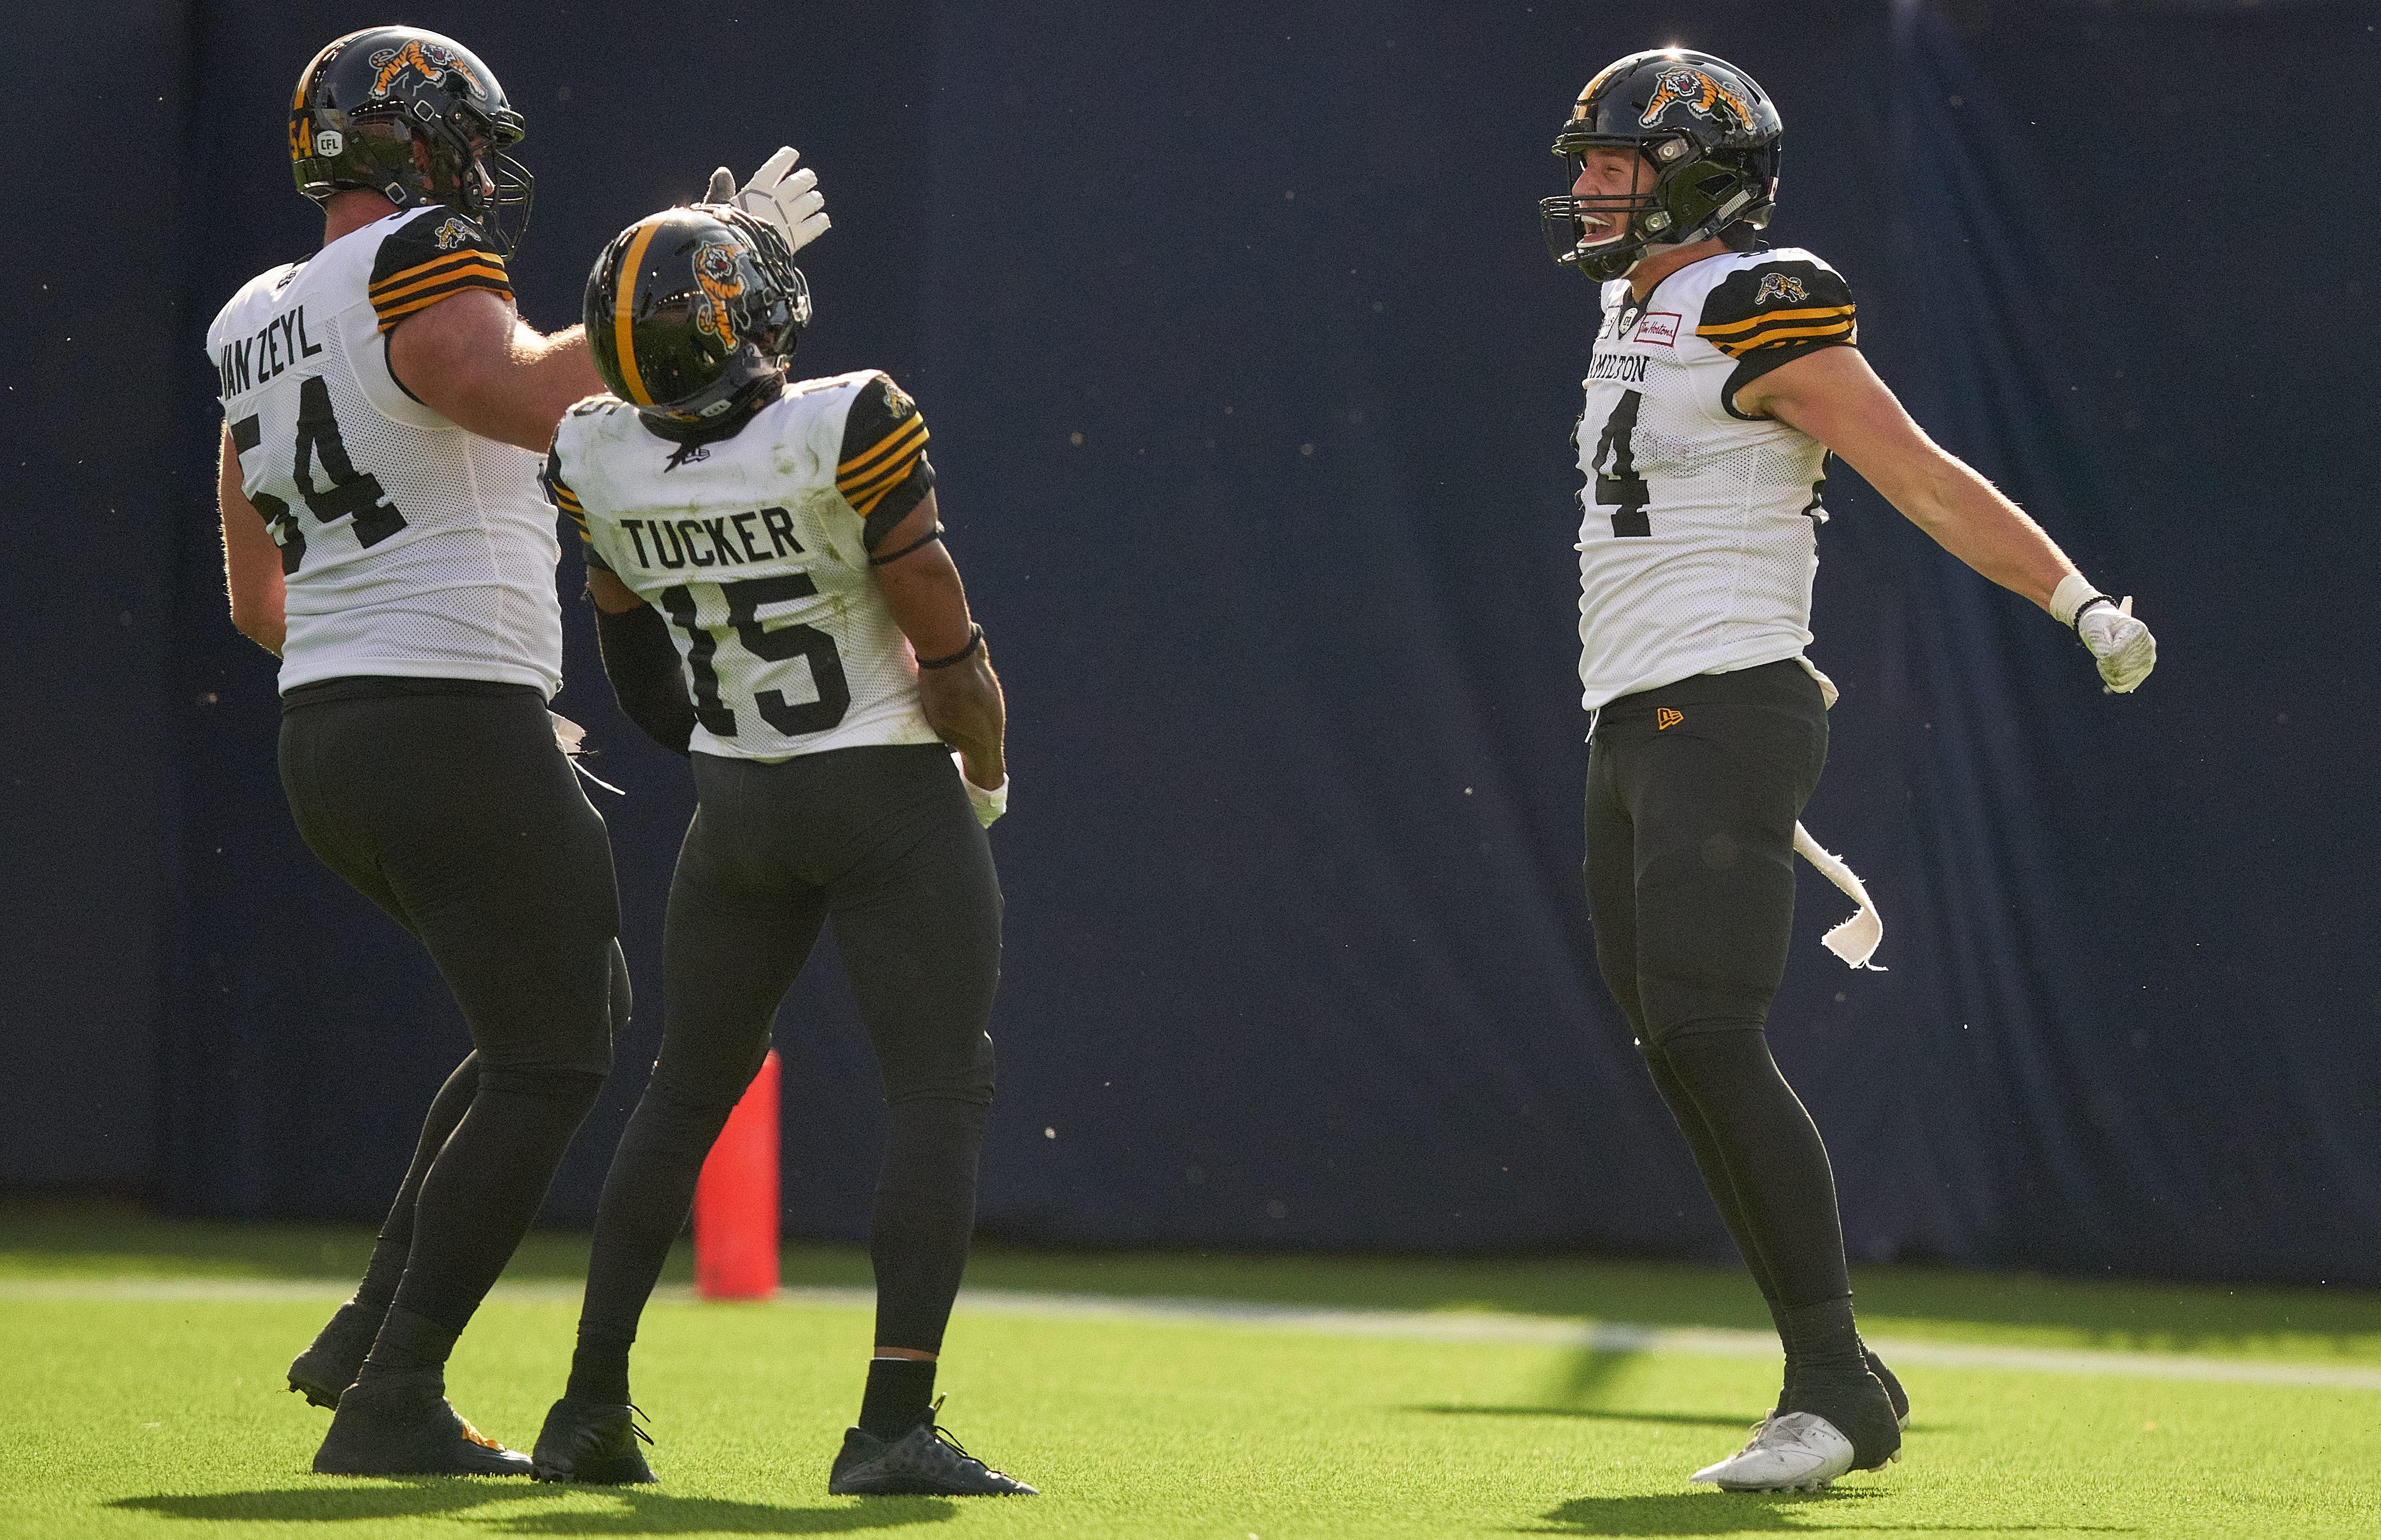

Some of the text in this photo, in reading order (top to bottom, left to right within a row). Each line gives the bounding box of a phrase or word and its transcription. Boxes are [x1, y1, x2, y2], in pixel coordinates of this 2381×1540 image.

[289, 117, 312, 161] 54
[320, 139, 338, 150] CFL
[221, 305, 322, 401] VAN ZEYL
[1648, 321, 1673, 338] Hortons
[230, 375, 409, 574] 54
[620, 505, 806, 569] TUCKER
[659, 572, 852, 737] 15
